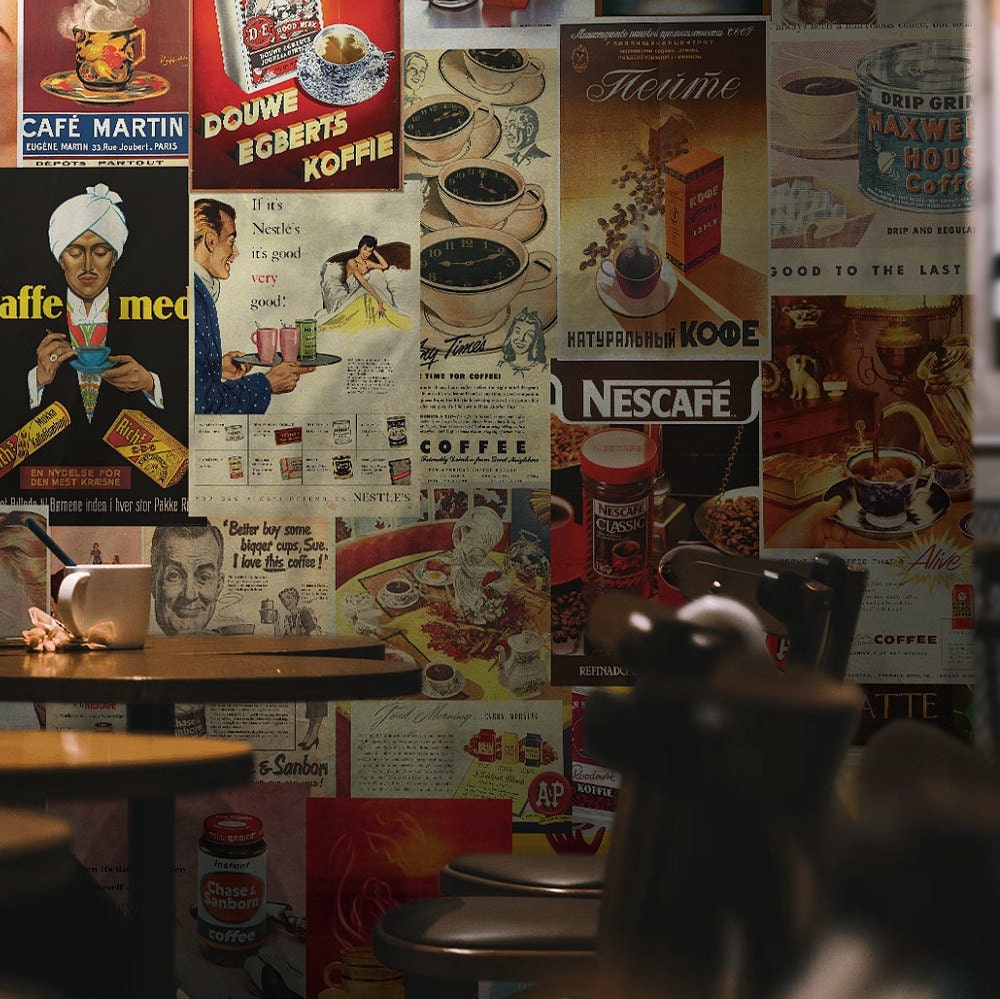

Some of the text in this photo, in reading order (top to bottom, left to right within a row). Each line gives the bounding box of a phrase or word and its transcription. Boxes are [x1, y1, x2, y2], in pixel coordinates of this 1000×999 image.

[586, 67, 743, 102] Пейте
[881, 92, 924, 109] DRIP
[201, 87, 299, 140] DOUWE
[23, 115, 183, 137] CAFÉ MARTIN
[236, 109, 348, 167] EGBERTS
[61, 142, 177, 151] MARTIN PARIS
[302, 130, 394, 183] KOFFIE
[252, 198, 283, 210] If it's
[887, 225, 933, 235] DRIP AND
[252, 248, 268, 259] it's
[835, 264, 961, 277] TO THE LAST
[252, 274, 278, 287] very
[568, 320, 760, 348] НАТУРАЛЬНЫЙ КОФЕ
[582, 380, 731, 418] NESCAFÉ
[420, 440, 527, 454] COFFEE
[31, 468, 121, 478] EN NYDELSE FOR
[31, 477, 120, 486] DEN MEST KRÆSNE
[284, 526, 311, 536] some
[596, 518, 645, 535] CLASSIC
[240, 538, 272, 556] bigger
[233, 553, 238, 568] I
[241, 554, 262, 568] love
[265, 553, 284, 568] this
[910, 543, 963, 571] Alive
[874, 634, 937, 645] COFFEE
[213, 859, 251, 869] instant
[206, 880, 248, 898] Chase
[204, 894, 259, 910] Sanborn
[208, 928, 257, 943] coffee
